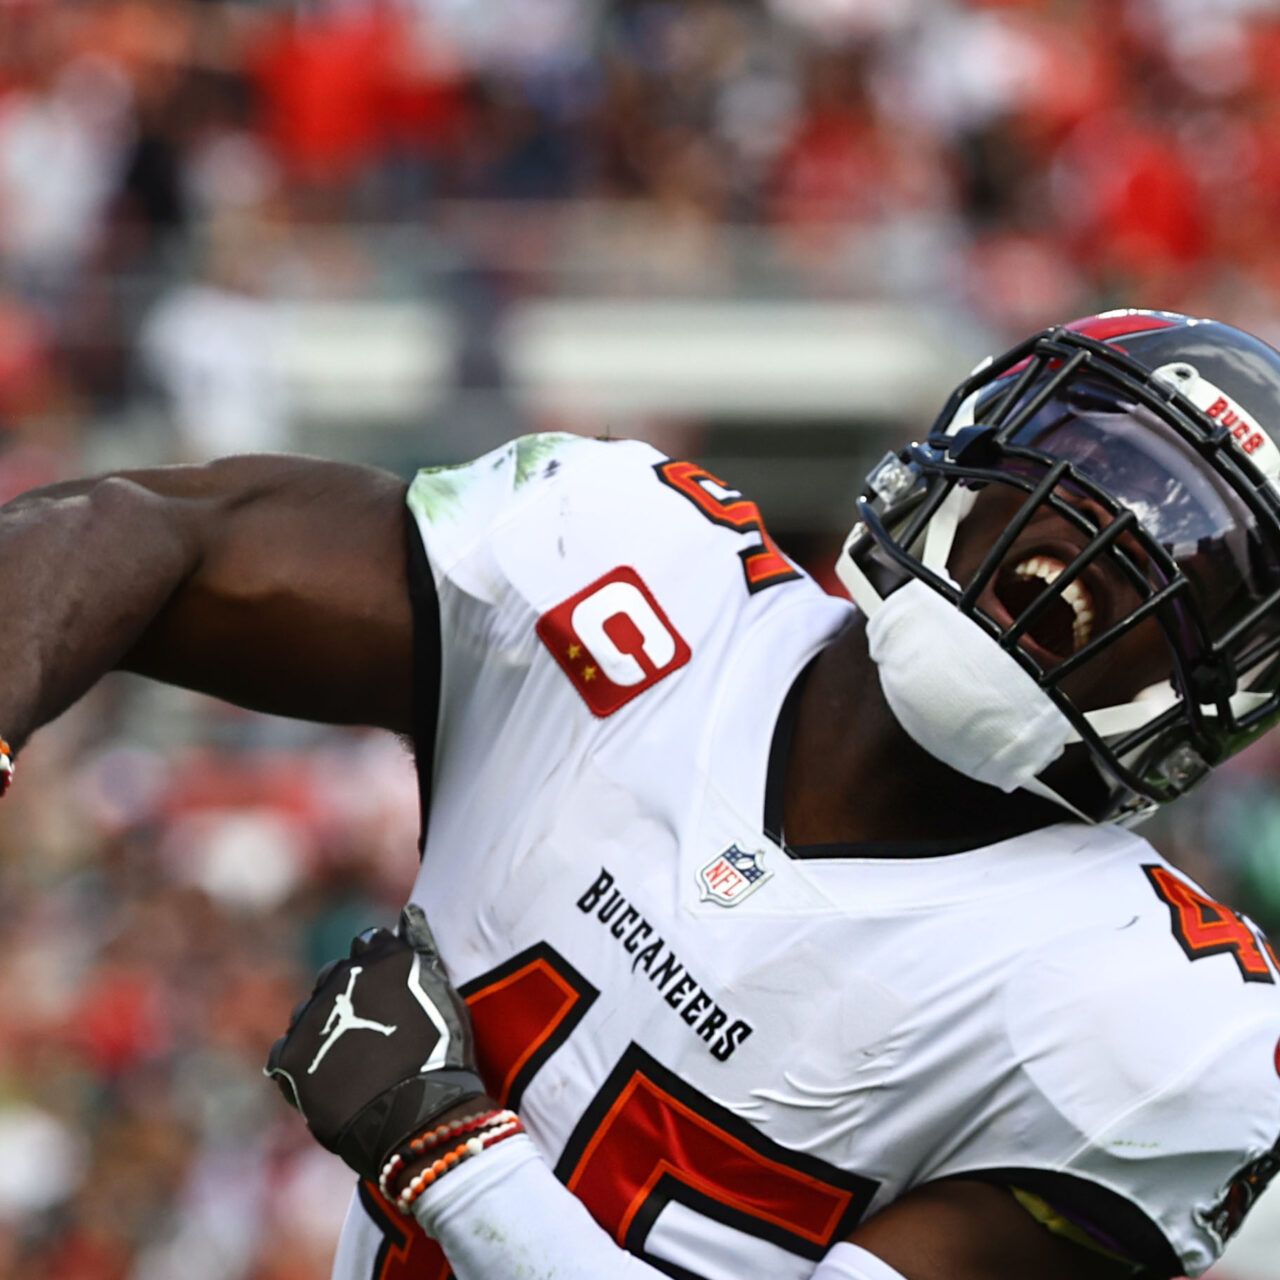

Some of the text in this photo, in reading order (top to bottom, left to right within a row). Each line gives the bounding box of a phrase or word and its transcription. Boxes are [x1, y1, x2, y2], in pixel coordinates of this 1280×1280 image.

[571, 581, 676, 687] C
[705, 859, 743, 898] NFL
[576, 865, 753, 1062] BUCCANEERS
